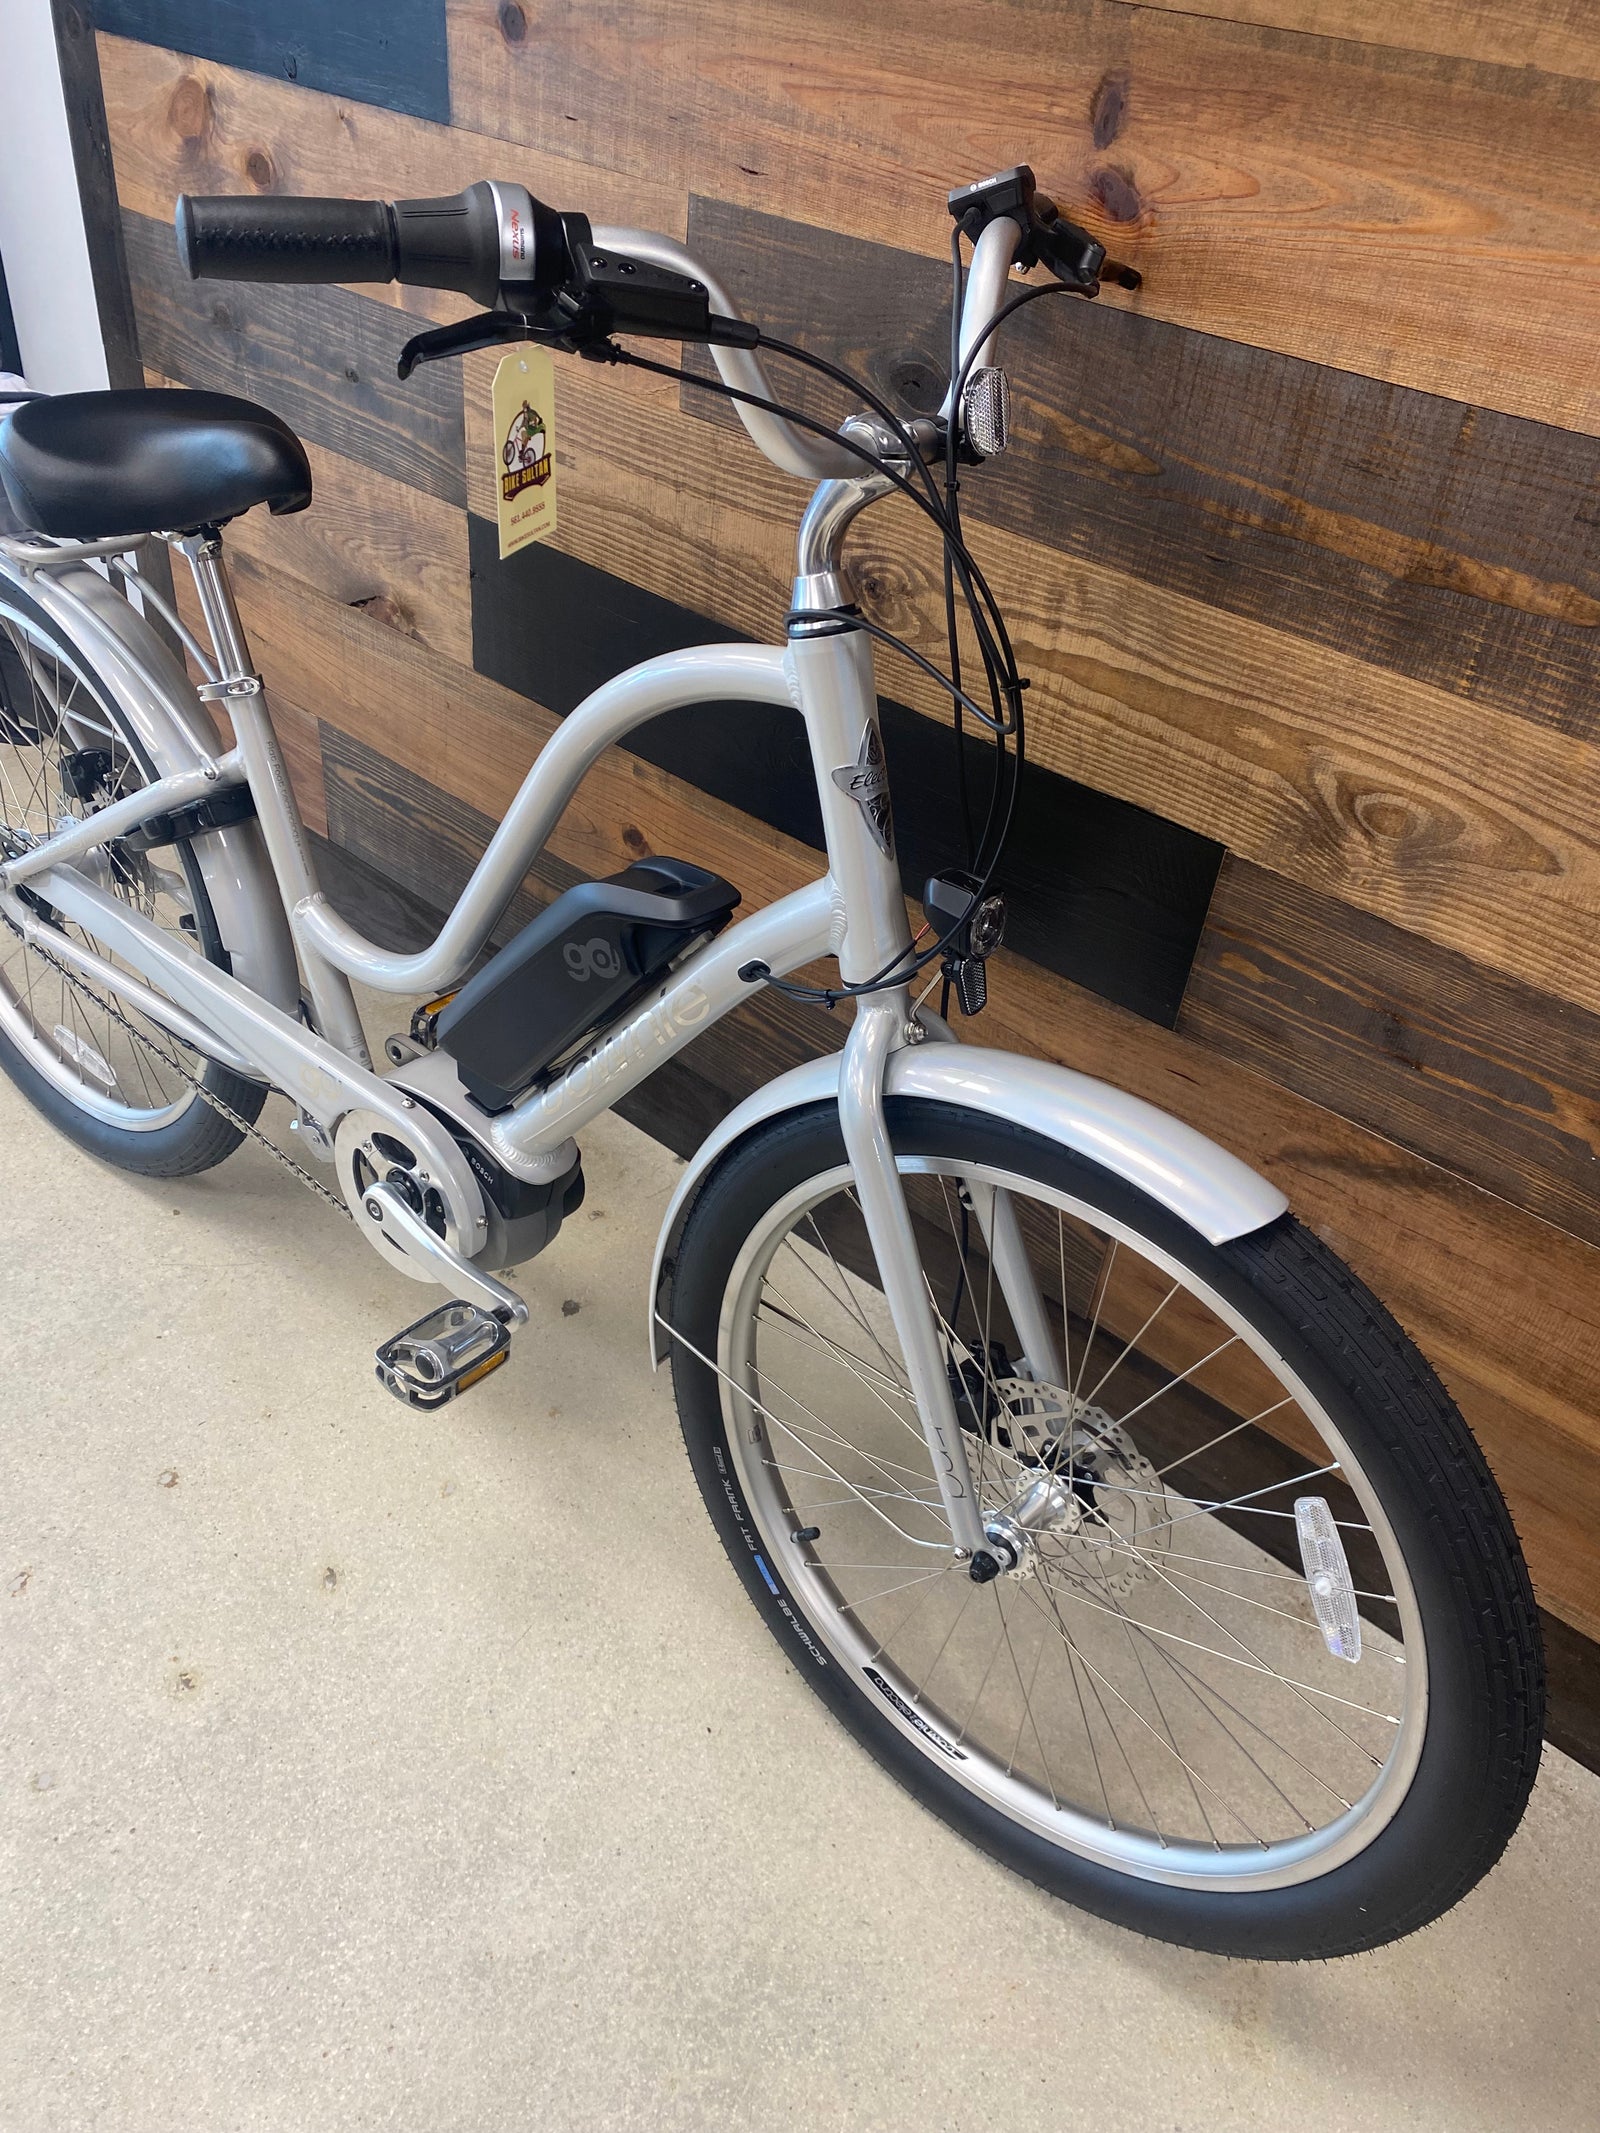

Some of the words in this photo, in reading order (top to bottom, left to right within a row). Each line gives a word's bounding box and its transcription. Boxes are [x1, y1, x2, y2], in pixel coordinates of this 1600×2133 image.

[504, 473, 520, 493] BIKE
[521, 458, 549, 484] SULTAN
[471, 1157, 494, 1185] BOSCH
[721, 1479, 744, 1521] FRANK
[740, 1526, 758, 1551] FAT
[776, 1598, 828, 1666] SCHWALBE
[874, 1677, 912, 1716] electra
